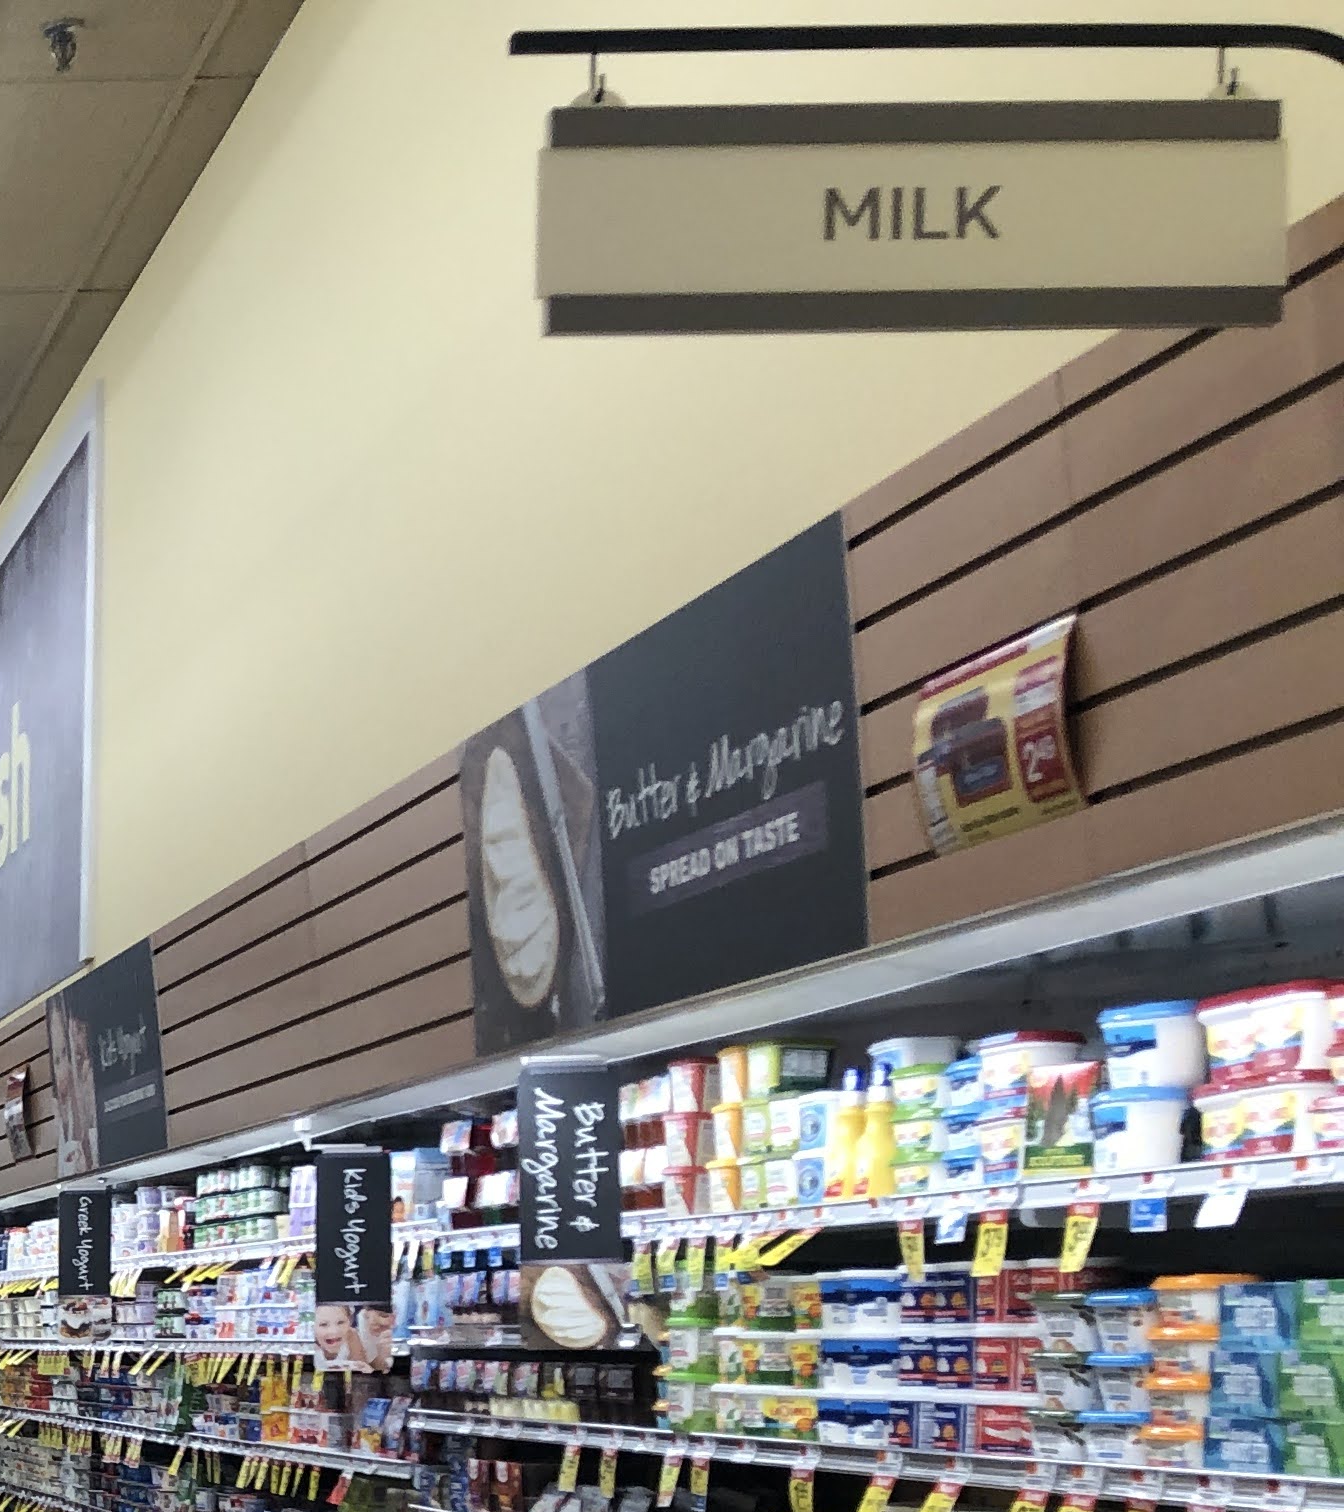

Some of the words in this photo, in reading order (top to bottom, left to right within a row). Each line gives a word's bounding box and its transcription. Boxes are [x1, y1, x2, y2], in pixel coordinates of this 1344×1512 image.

[822, 183, 1003, 242] MILK
[605, 762, 679, 842] Butter
[704, 699, 846, 800] Margarine
[648, 846, 711, 895] SPREAD
[713, 836, 740, 870] ON
[740, 812, 801, 858] TASTE
[342, 1167, 367, 1215] Kids
[520, 1086, 564, 1251] Margarine
[572, 1101, 609, 1208] Butter
[78, 1195, 93, 1237] Greek
[71, 1239, 94, 1291] Yogurt
[333, 1217, 368, 1295] Yogurt
